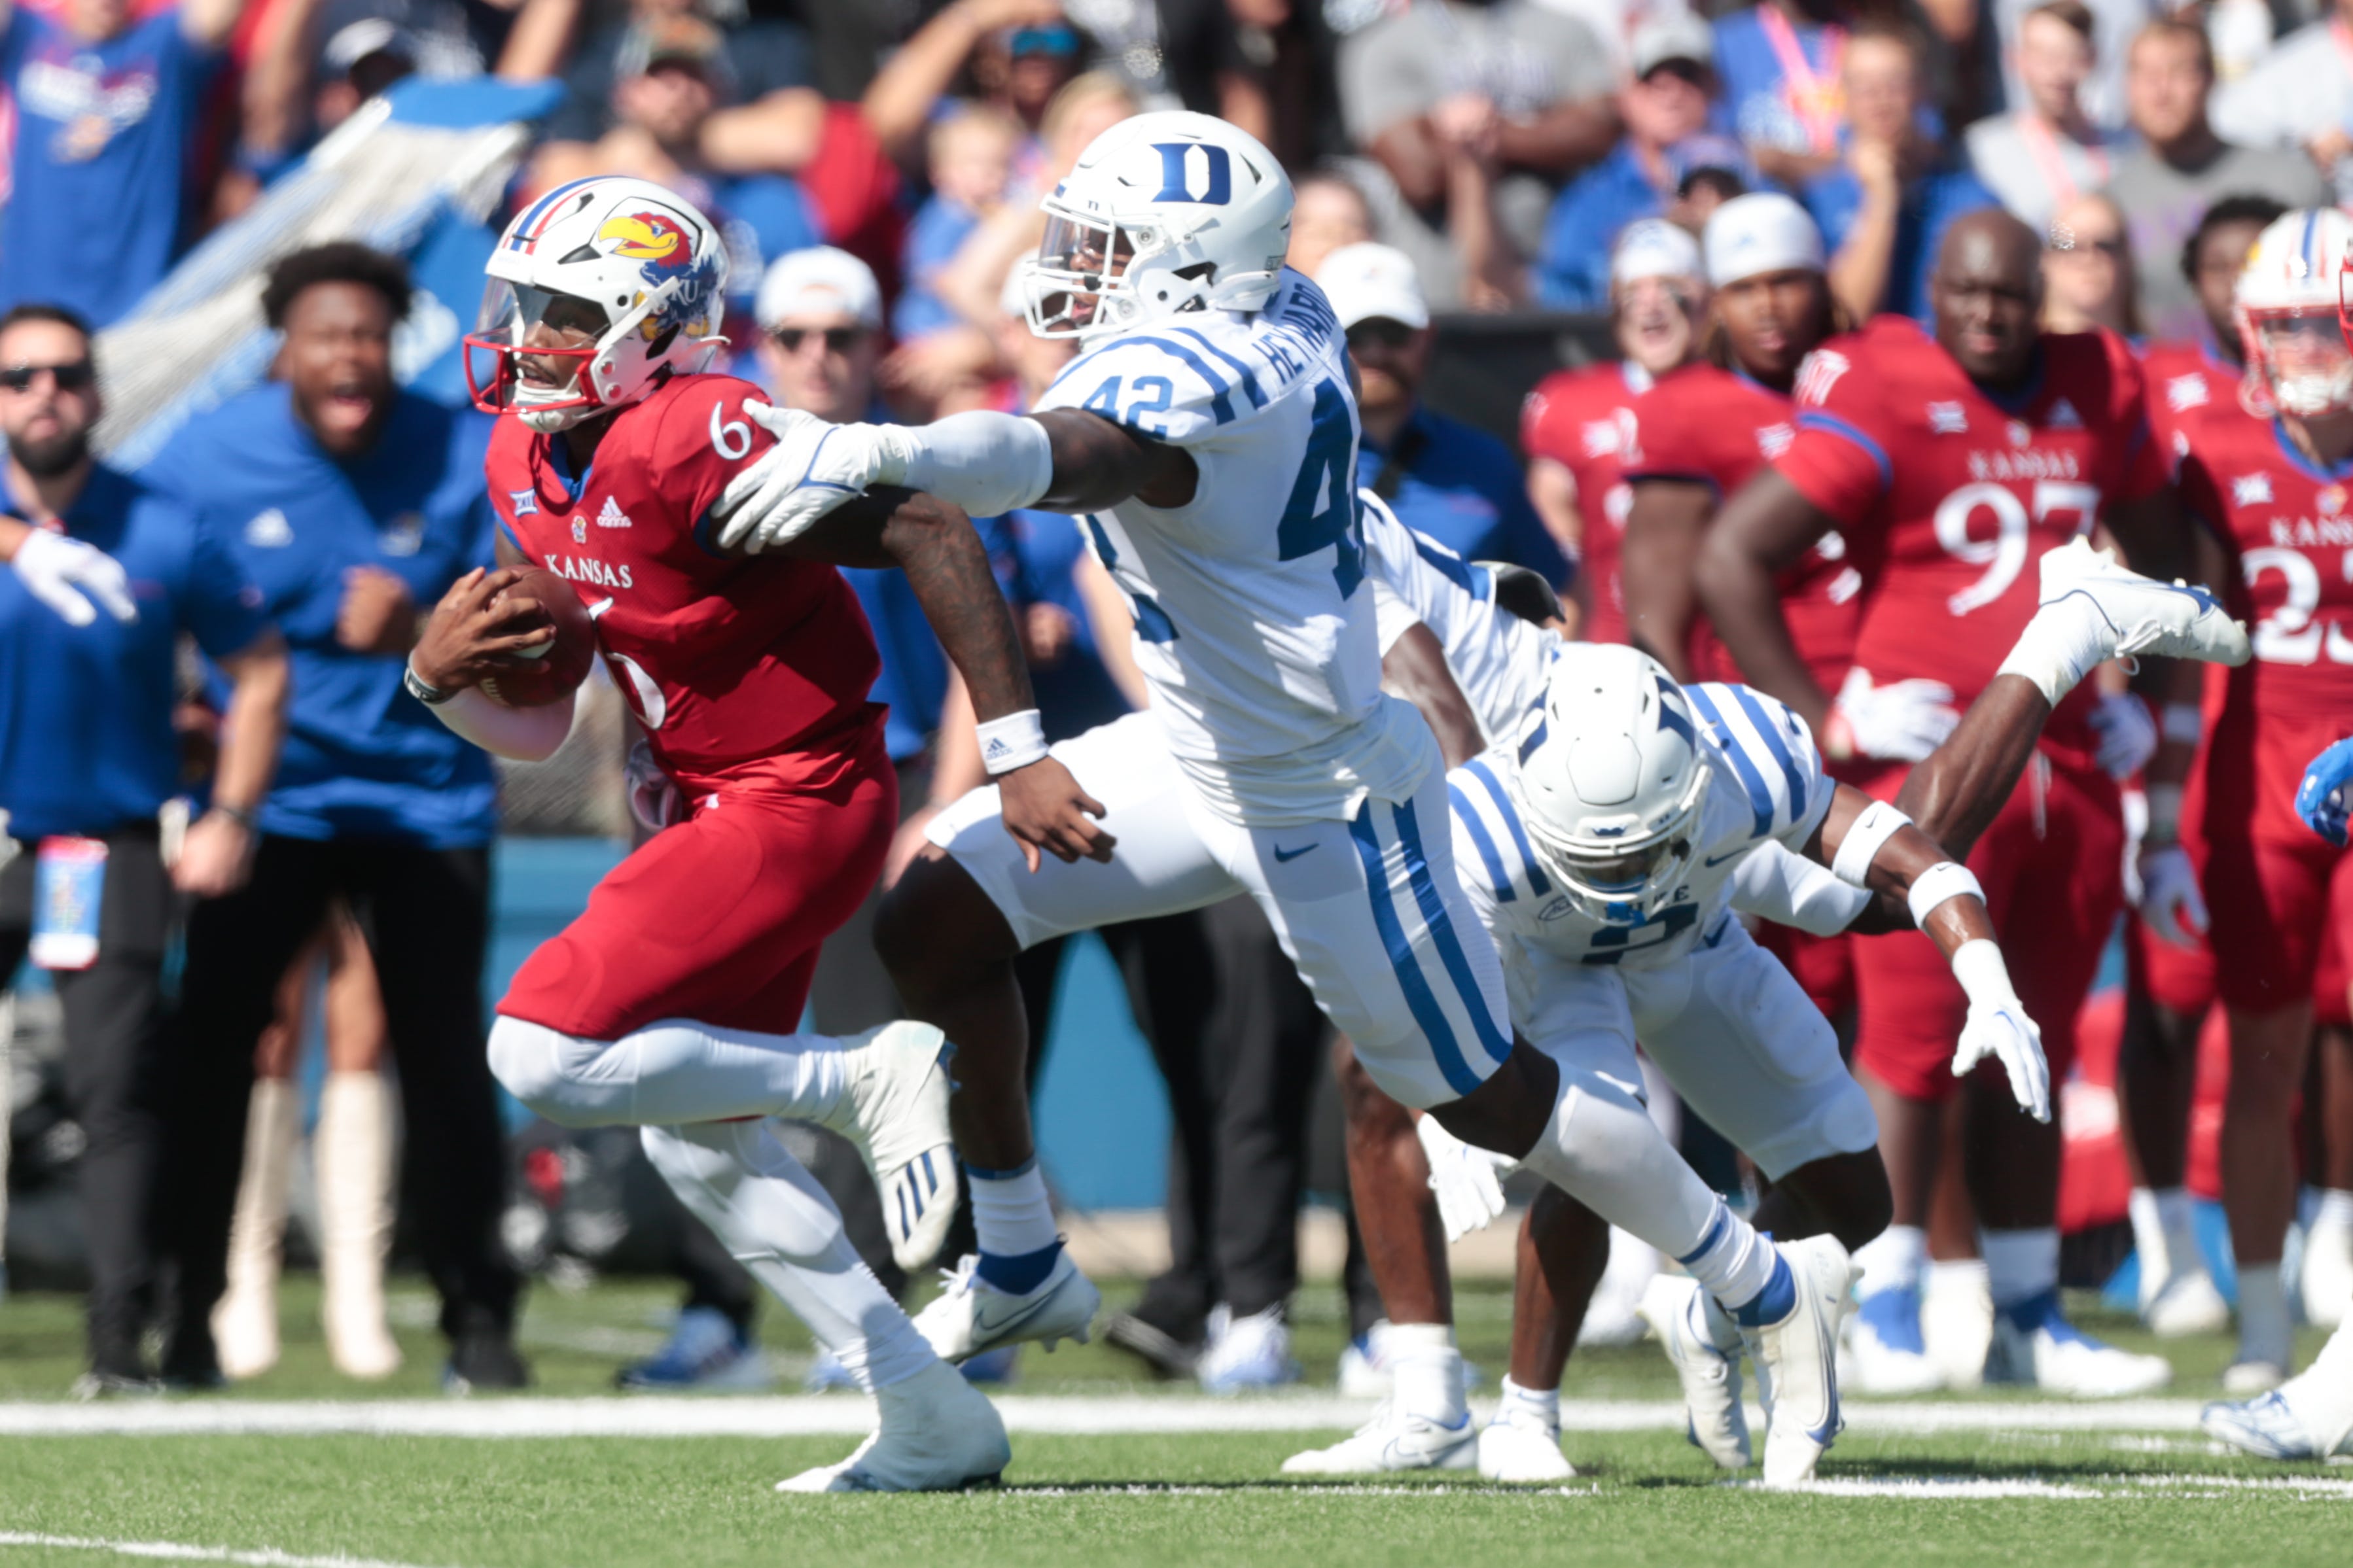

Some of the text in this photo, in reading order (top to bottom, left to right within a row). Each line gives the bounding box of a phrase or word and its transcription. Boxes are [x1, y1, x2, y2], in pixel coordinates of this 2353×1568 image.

[1149, 143, 1231, 205] D
[1251, 283, 1336, 385] HEYWARD
[709, 400, 752, 461] 6
[1082, 375, 1173, 440] 42
[1277, 375, 1366, 602] 4
[544, 554, 633, 589] KANSAS
[1933, 481, 2101, 617] 97
